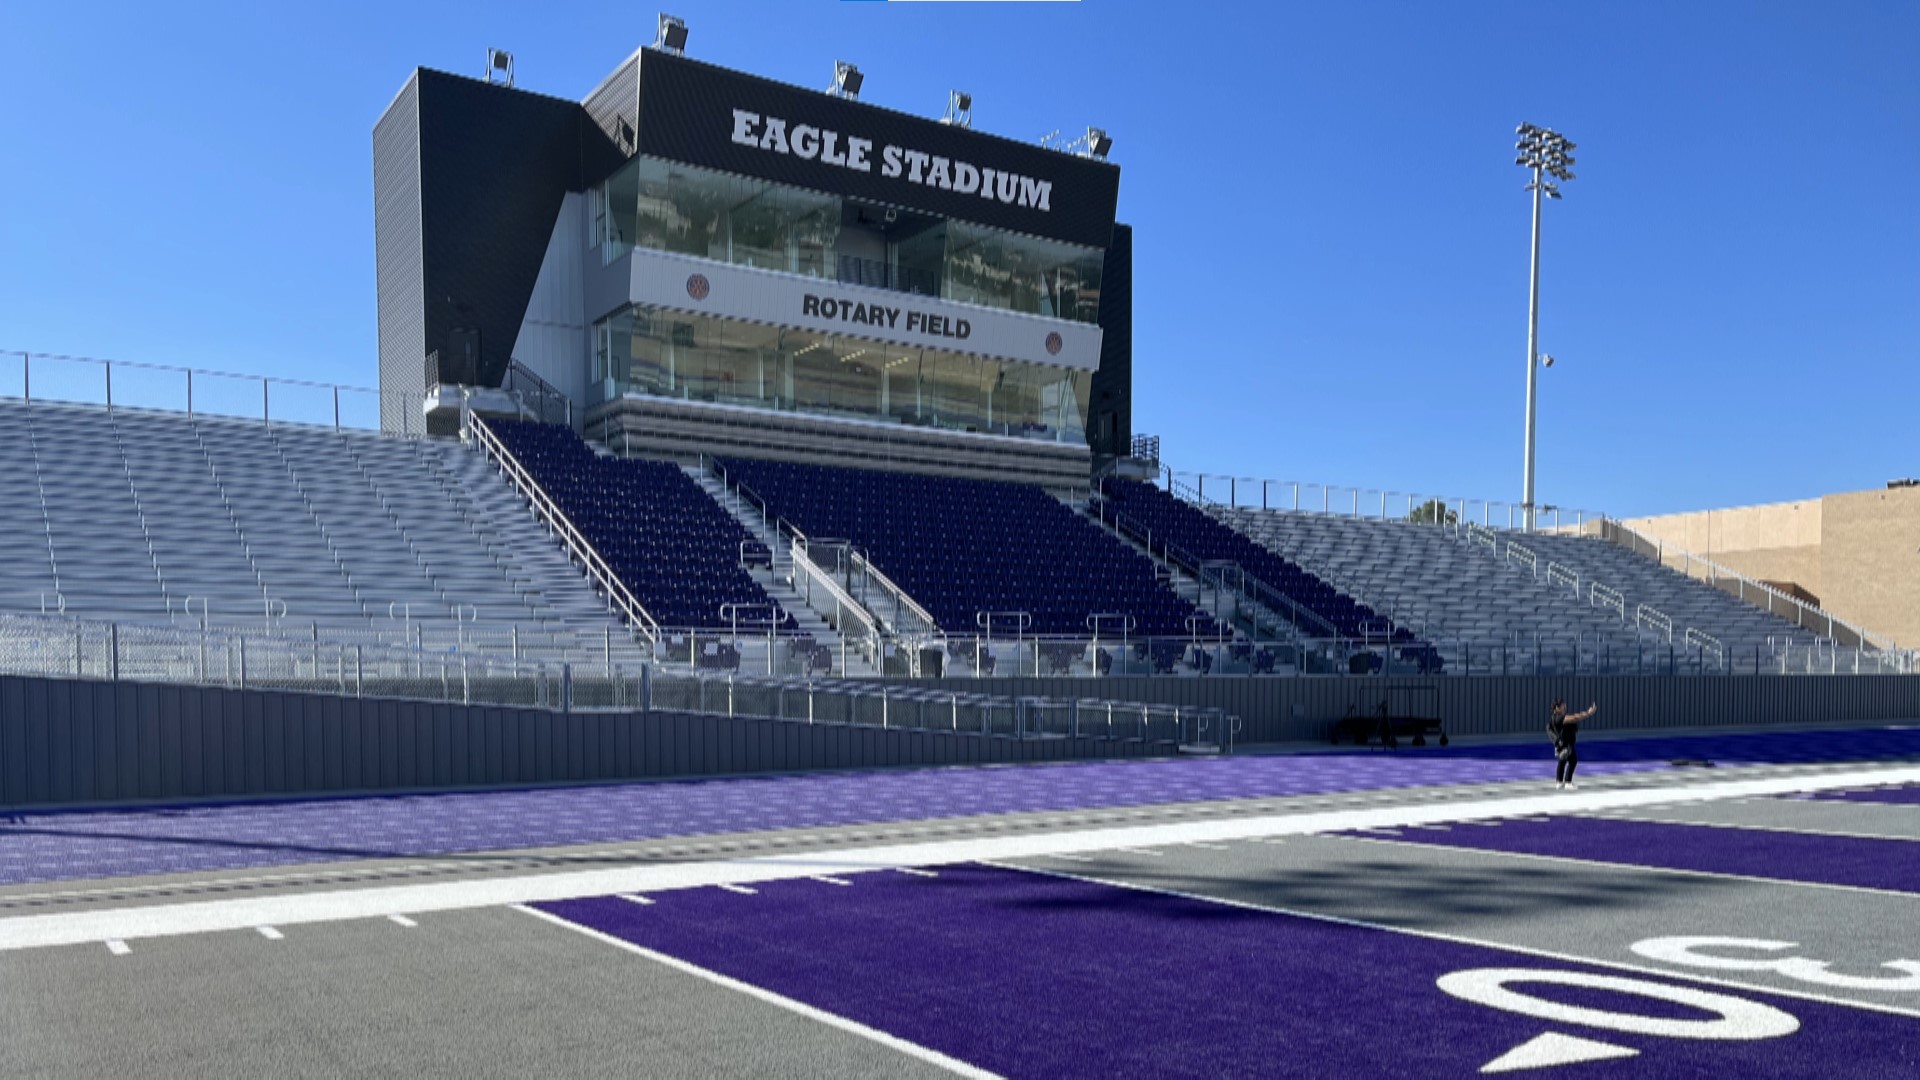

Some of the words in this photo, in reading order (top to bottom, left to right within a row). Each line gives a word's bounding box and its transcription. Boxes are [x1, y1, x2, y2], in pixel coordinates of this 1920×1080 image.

[731, 108, 873, 172] EAGLE
[881, 144, 1053, 212] STADIUM
[802, 293, 901, 329] ROTARY
[906, 310, 971, 340] FIELD
